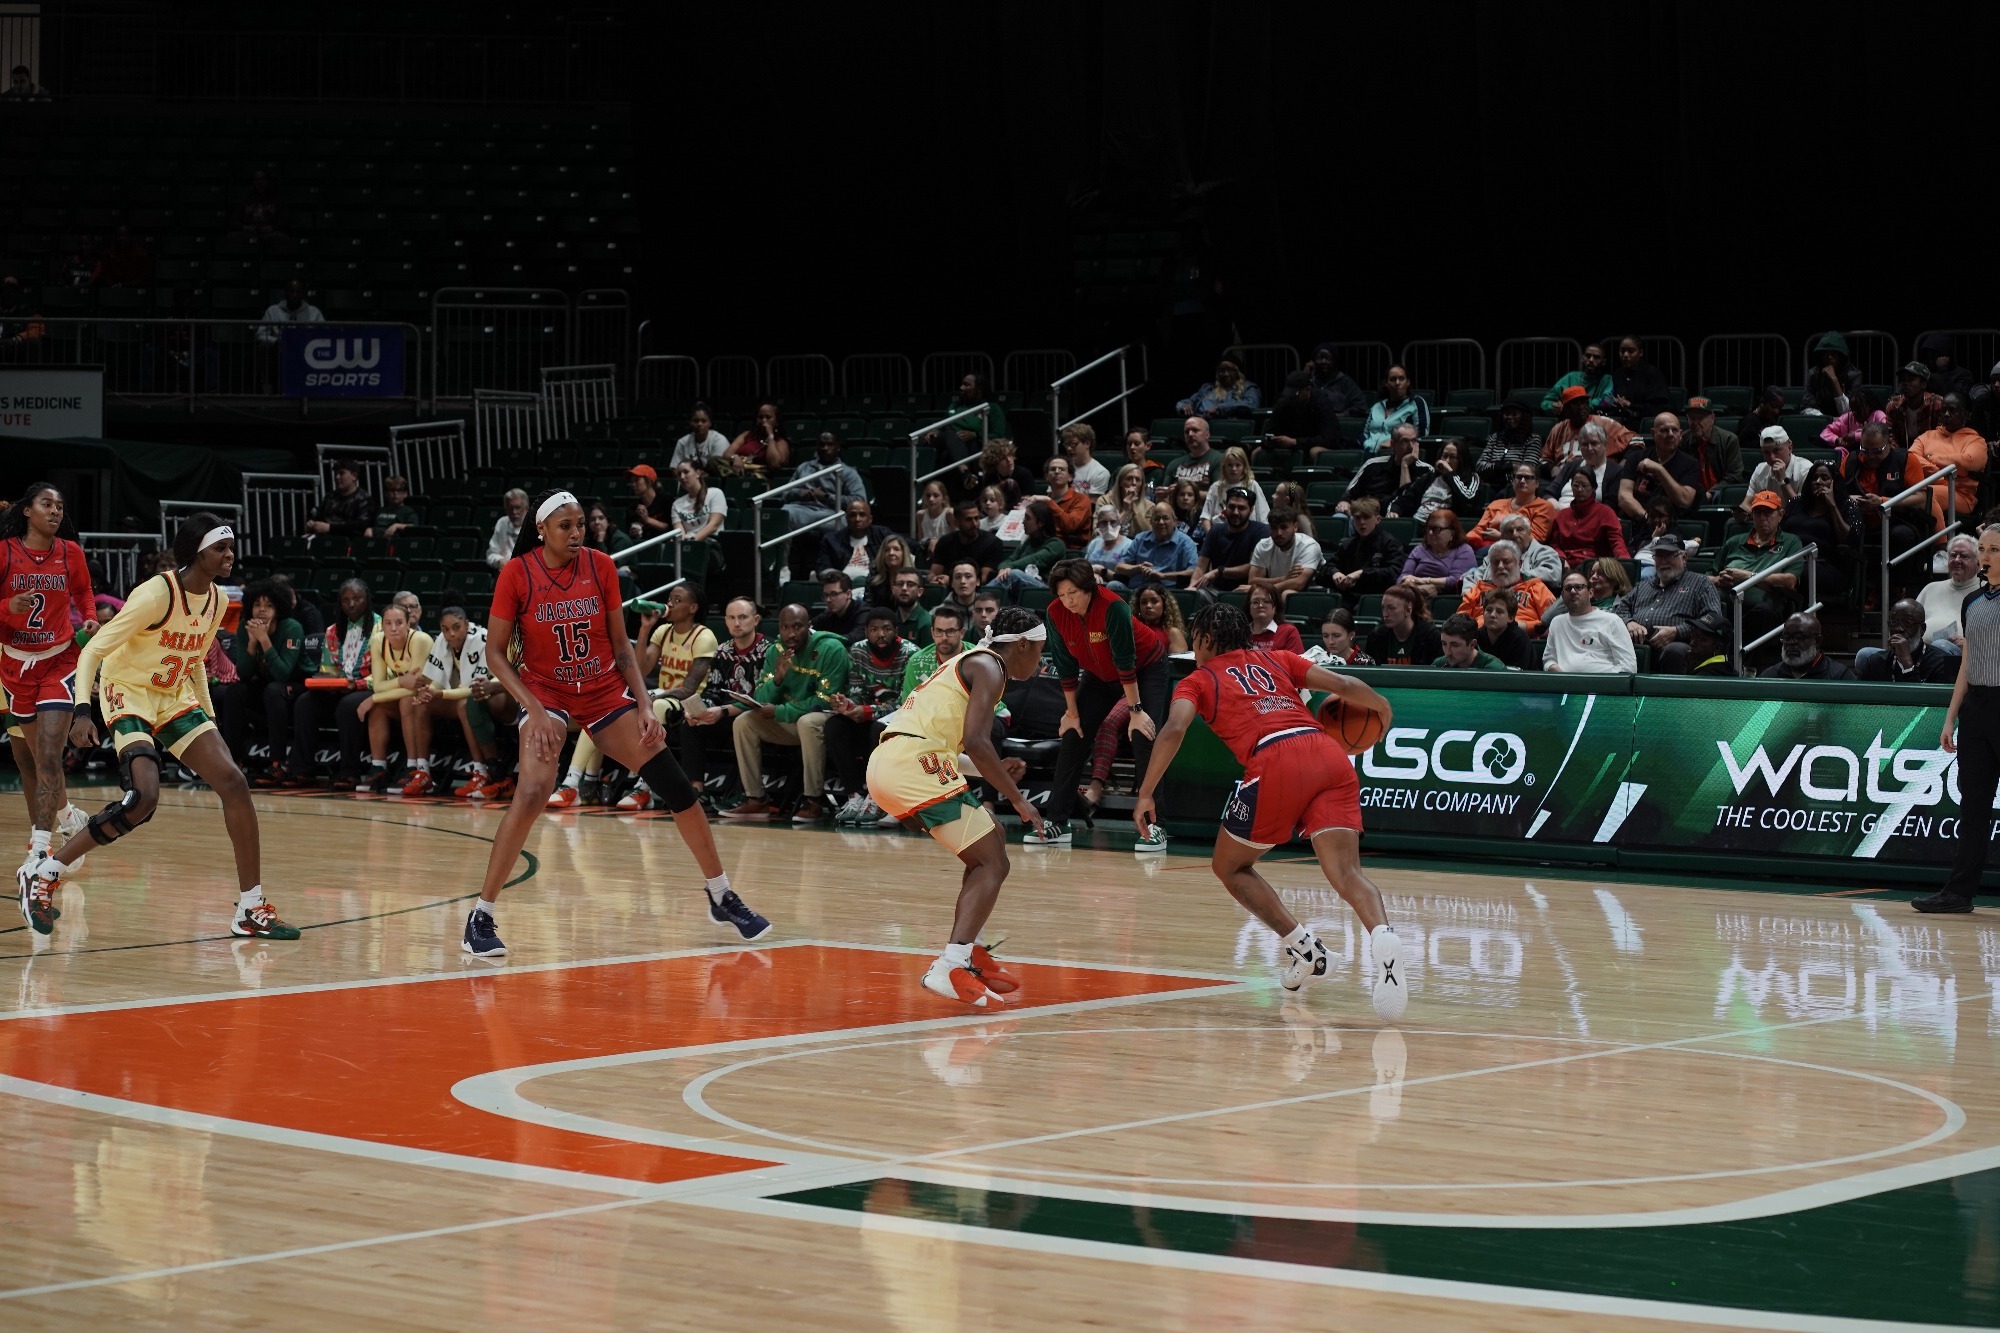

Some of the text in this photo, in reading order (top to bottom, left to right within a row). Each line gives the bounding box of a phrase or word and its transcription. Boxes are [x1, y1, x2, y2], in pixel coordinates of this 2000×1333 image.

[304, 337, 381, 370] CW
[317, 350, 331, 358] THE
[305, 372, 382, 387] SPORTS
[13, 397, 82, 410] MEDICINE
[0, 413, 32, 427] UTE
[11, 573, 67, 591] JACKSON
[27, 592, 46, 630] 2
[534, 596, 600, 623] JACKSON
[12, 630, 56, 646] STATE
[158, 629, 207, 652] MIAM
[552, 618, 592, 664] 15
[554, 655, 602, 683] STATE
[1225, 663, 1277, 696] 10
[1347, 727, 1527, 785] tsco
[1716, 728, 1962, 807] wats
[1359, 786, 1521, 815] GREEN COMPANY
[1716, 805, 1756, 828] THE
[1759, 808, 1857, 834] COOLEST
